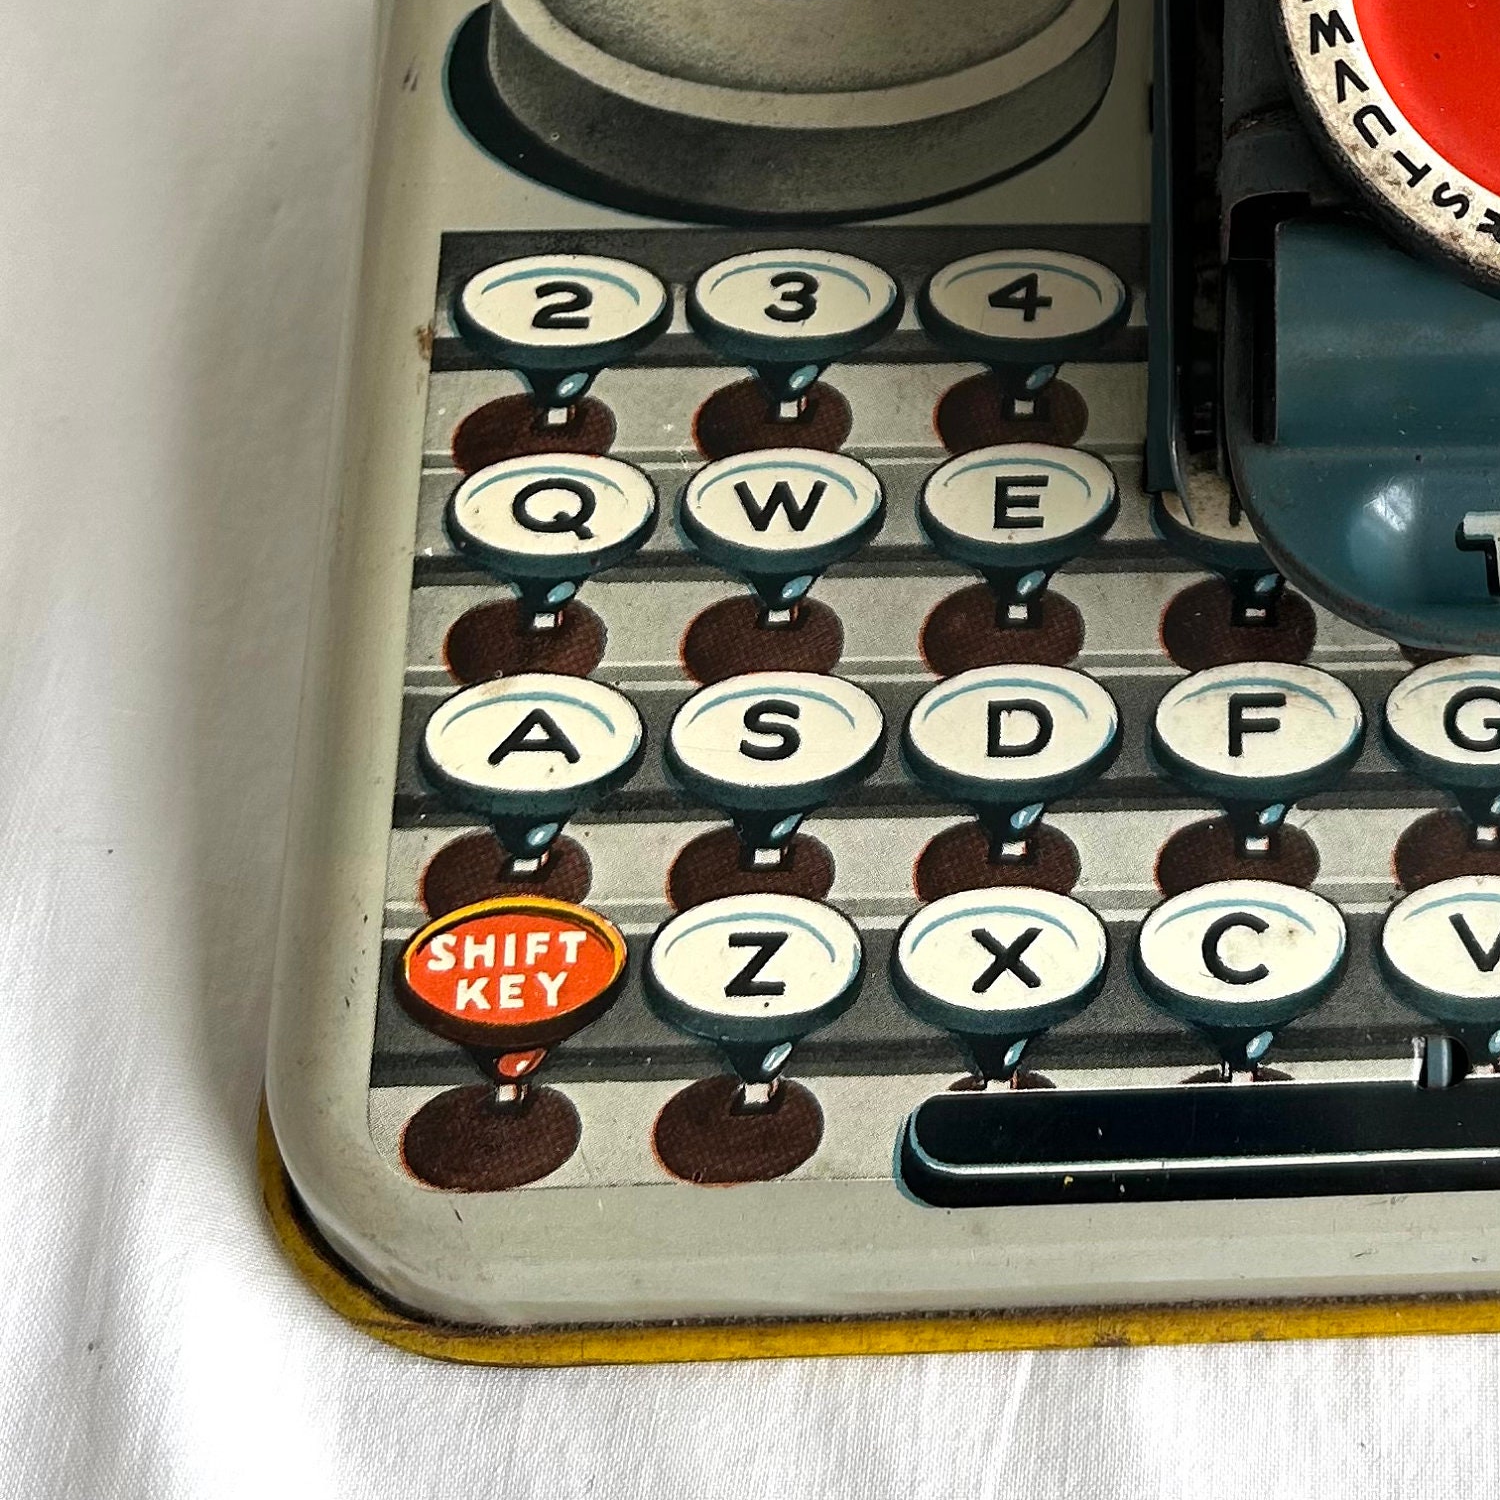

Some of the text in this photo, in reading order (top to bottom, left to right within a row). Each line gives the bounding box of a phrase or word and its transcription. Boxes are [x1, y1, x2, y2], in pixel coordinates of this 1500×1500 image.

[1310, 10, 1354, 55] W
[1335, 59, 1369, 104] V
[1353, 105, 1396, 149] U
[1391, 150, 1432, 188] T
[1430, 182, 1469, 219] S
[532, 282, 592, 329] 2
[764, 272, 819, 322] 3
[988, 273, 1052, 322] 4
[512, 478, 596, 540] Q
[734, 480, 827, 531] W
[993, 475, 1049, 529] E
[488, 709, 580, 766] A
[739, 700, 801, 761] S
[986, 699, 1053, 758] D
[1228, 693, 1287, 758] F
[427, 931, 587, 971] SHIFT
[724, 932, 788, 997] Z
[972, 928, 1043, 994] X
[1202, 912, 1269, 985] C
[456, 971, 568, 1011] KEY
